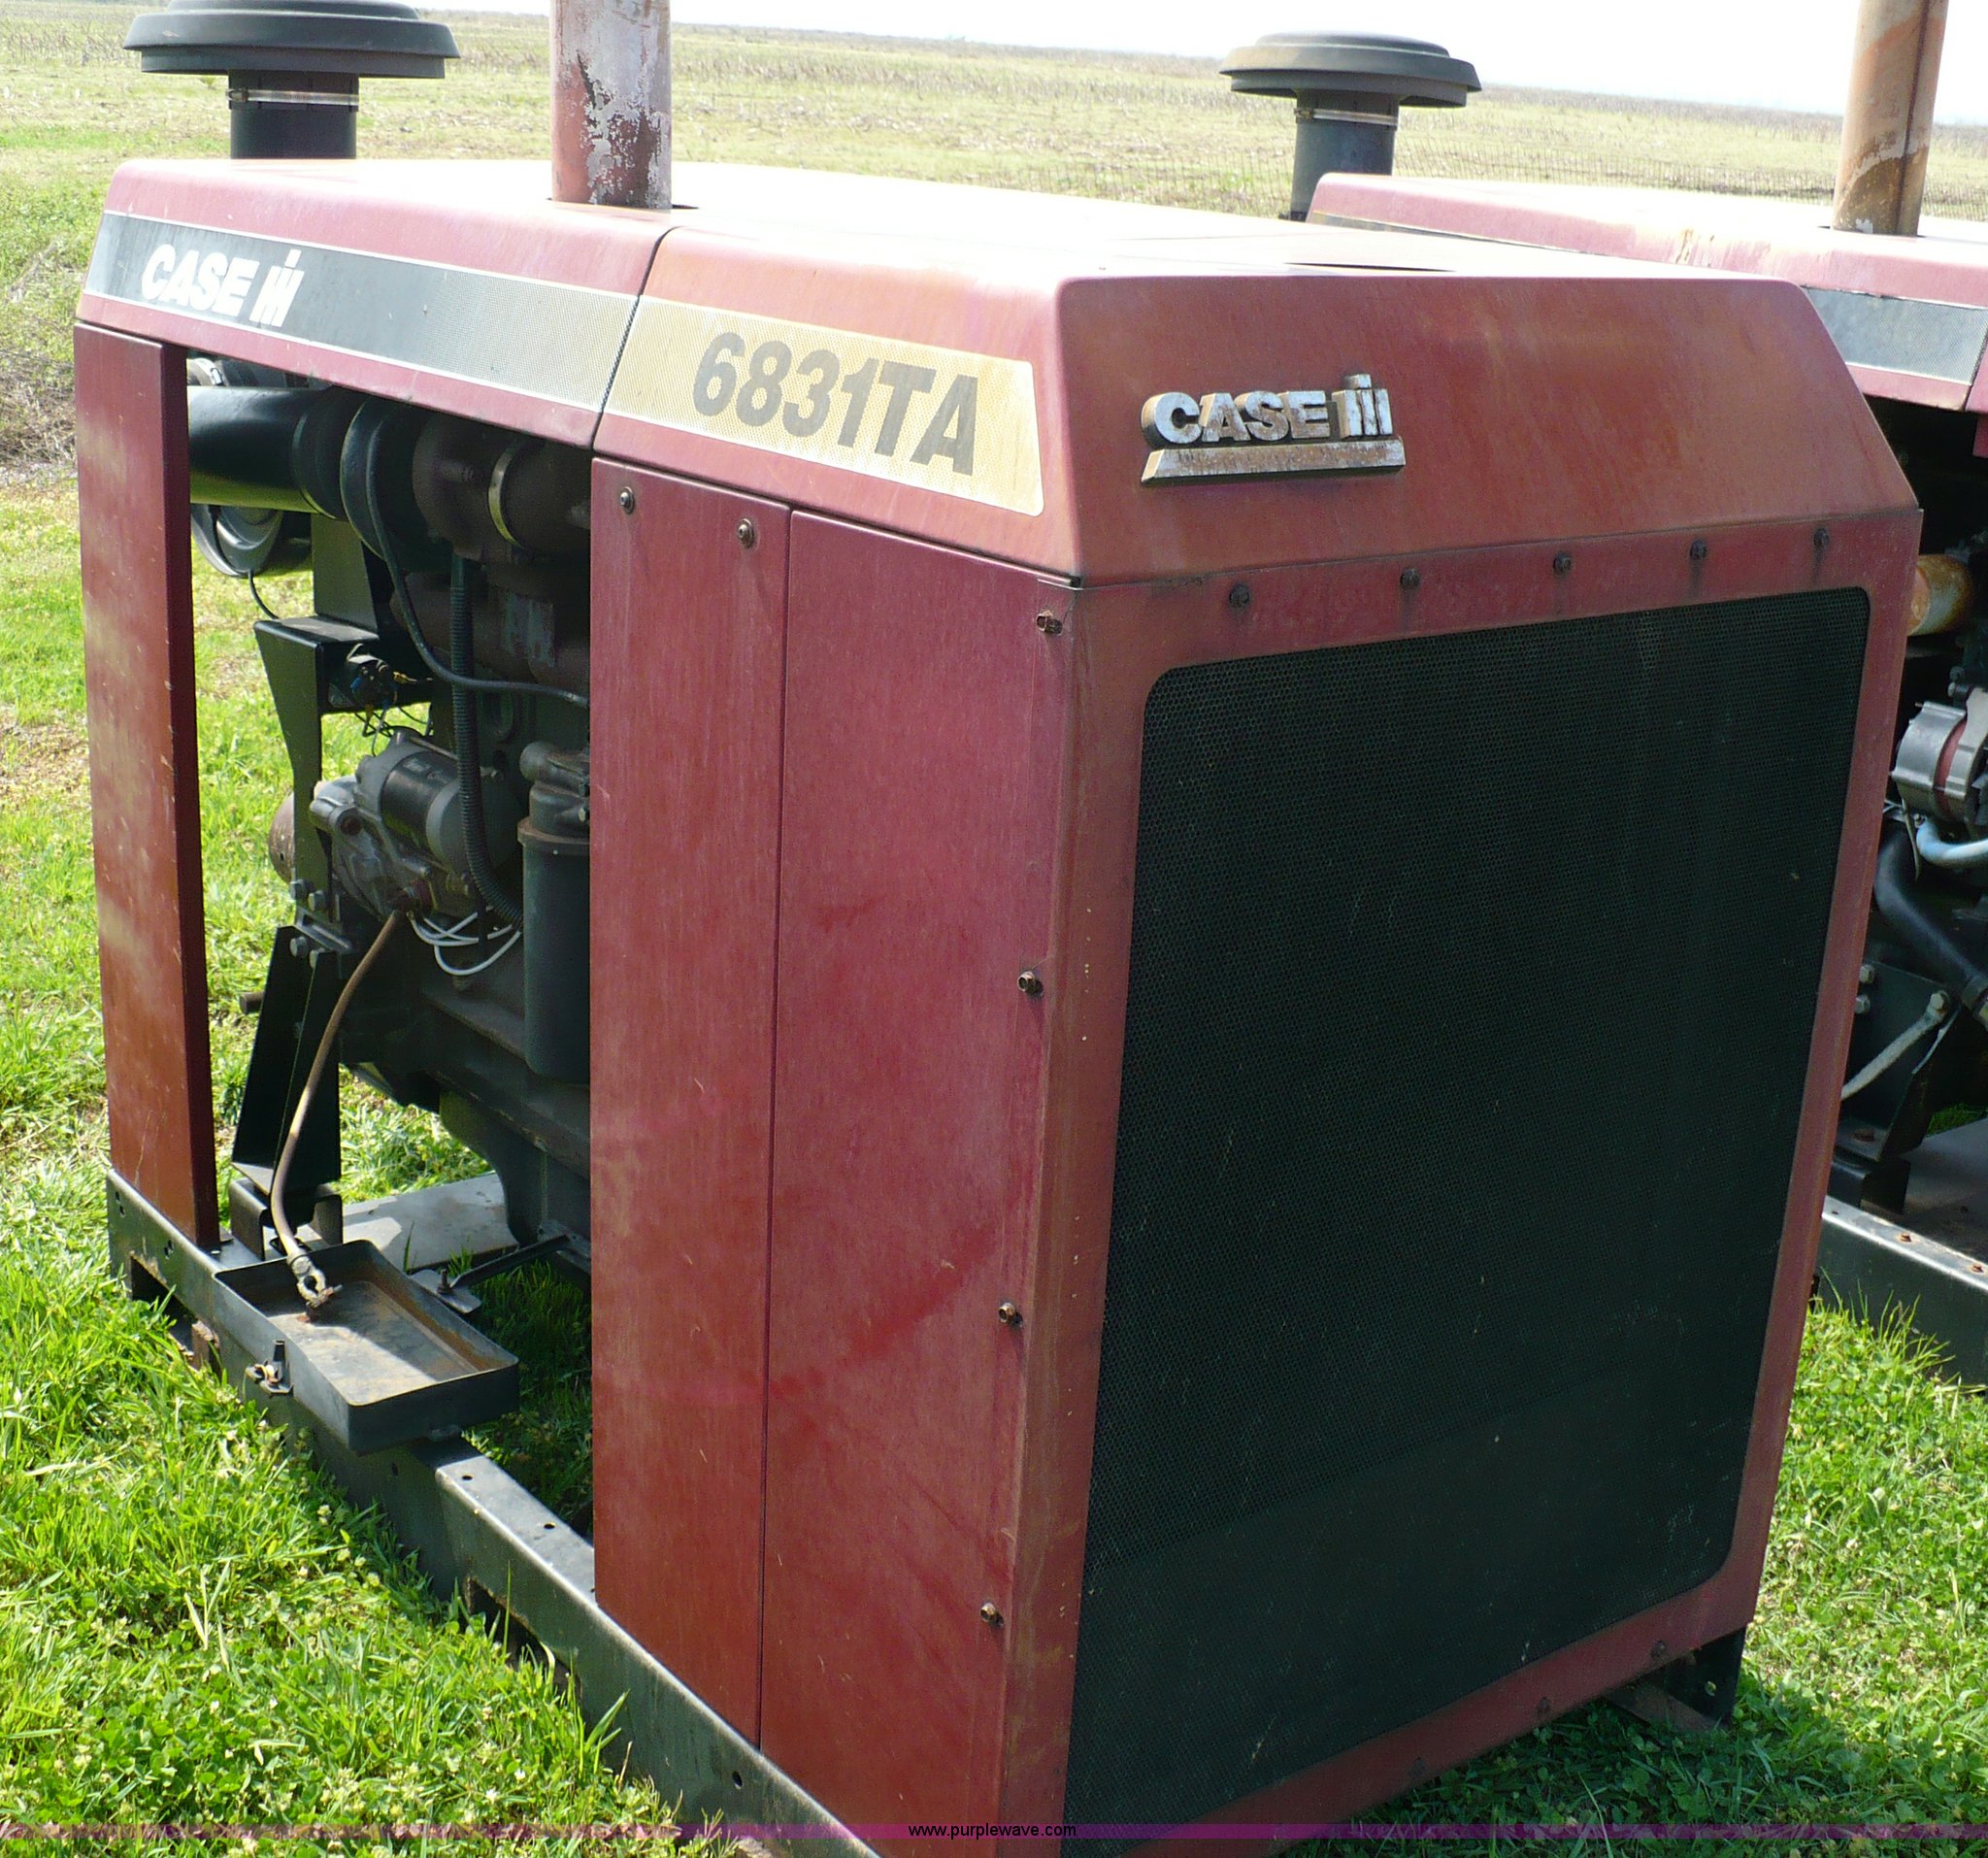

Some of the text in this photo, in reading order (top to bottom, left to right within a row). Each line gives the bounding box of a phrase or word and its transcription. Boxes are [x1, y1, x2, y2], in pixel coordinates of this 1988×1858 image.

[141, 244, 260, 317] CASE
[692, 331, 979, 477] 6831TA
[1141, 390, 1331, 446] CASE
